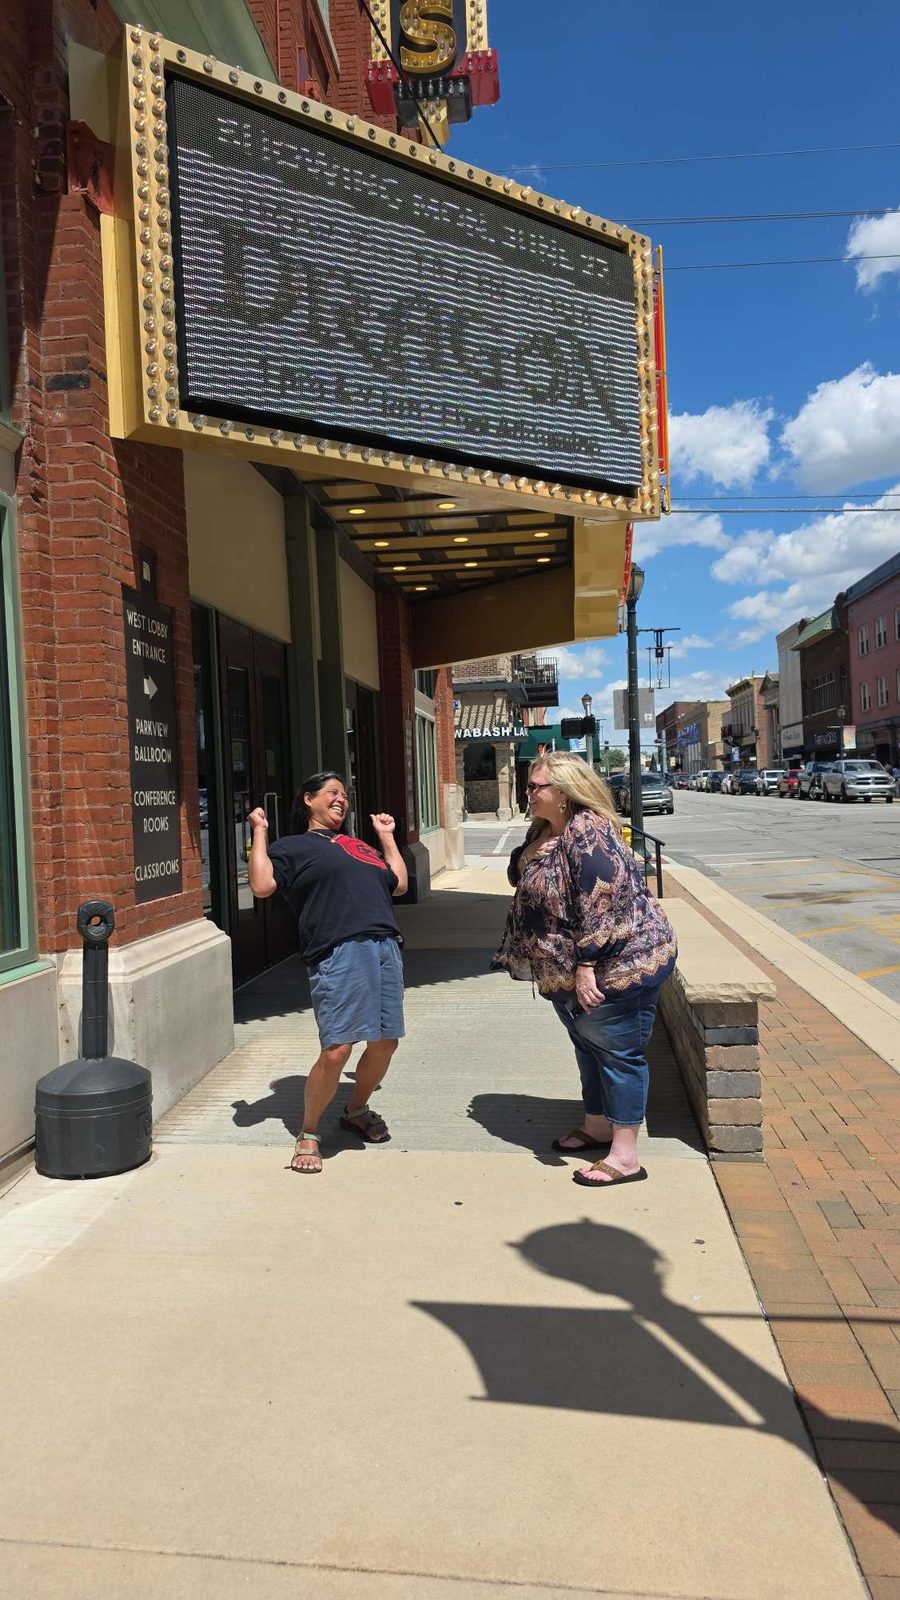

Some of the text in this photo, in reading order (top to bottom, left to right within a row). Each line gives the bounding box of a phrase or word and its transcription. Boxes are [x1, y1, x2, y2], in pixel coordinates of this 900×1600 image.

[399, 0, 457, 74] S
[201, 214, 627, 430] DRAGON
[127, 609, 168, 639] WEST LOBBY
[132, 639, 166, 664] ENTRANCE
[135, 718, 169, 737] PARKVIEW
[134, 745, 172, 763] BALLROOM
[133, 790, 176, 806] CONFERENCE
[143, 816, 169, 833] ROOMS
[134, 859, 180, 882] CLASSROOMS
